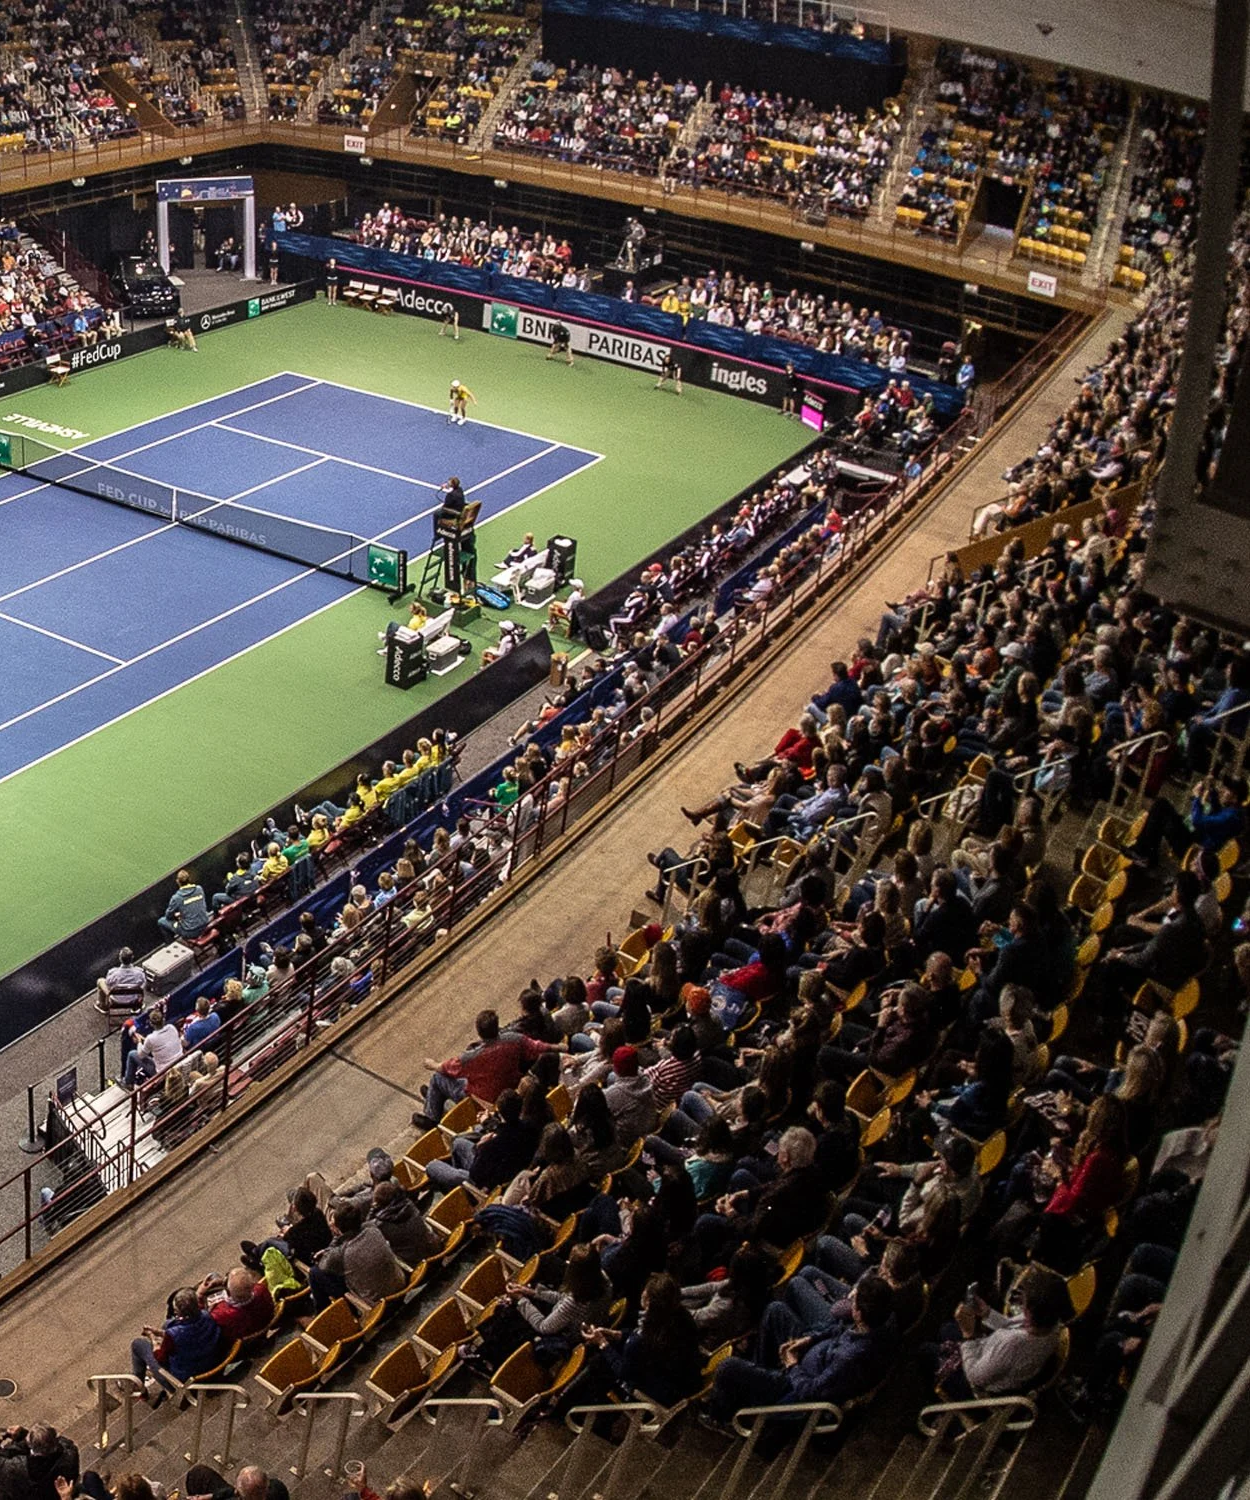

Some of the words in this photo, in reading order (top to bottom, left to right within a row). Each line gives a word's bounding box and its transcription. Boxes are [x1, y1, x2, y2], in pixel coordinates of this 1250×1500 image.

[346, 139, 363, 149] EXIT
[1031, 277, 1054, 291] EXIT
[71, 343, 121, 369] #FedCup
[588, 332, 666, 367] PARIBAS
[710, 362, 768, 395] ingles
[1, 413, 90, 440] ASHEVILLE
[97, 482, 124, 501] FED
[128, 492, 157, 509] CUP
[208, 518, 268, 546] PARIBAS
[392, 646, 404, 682] Adecco
